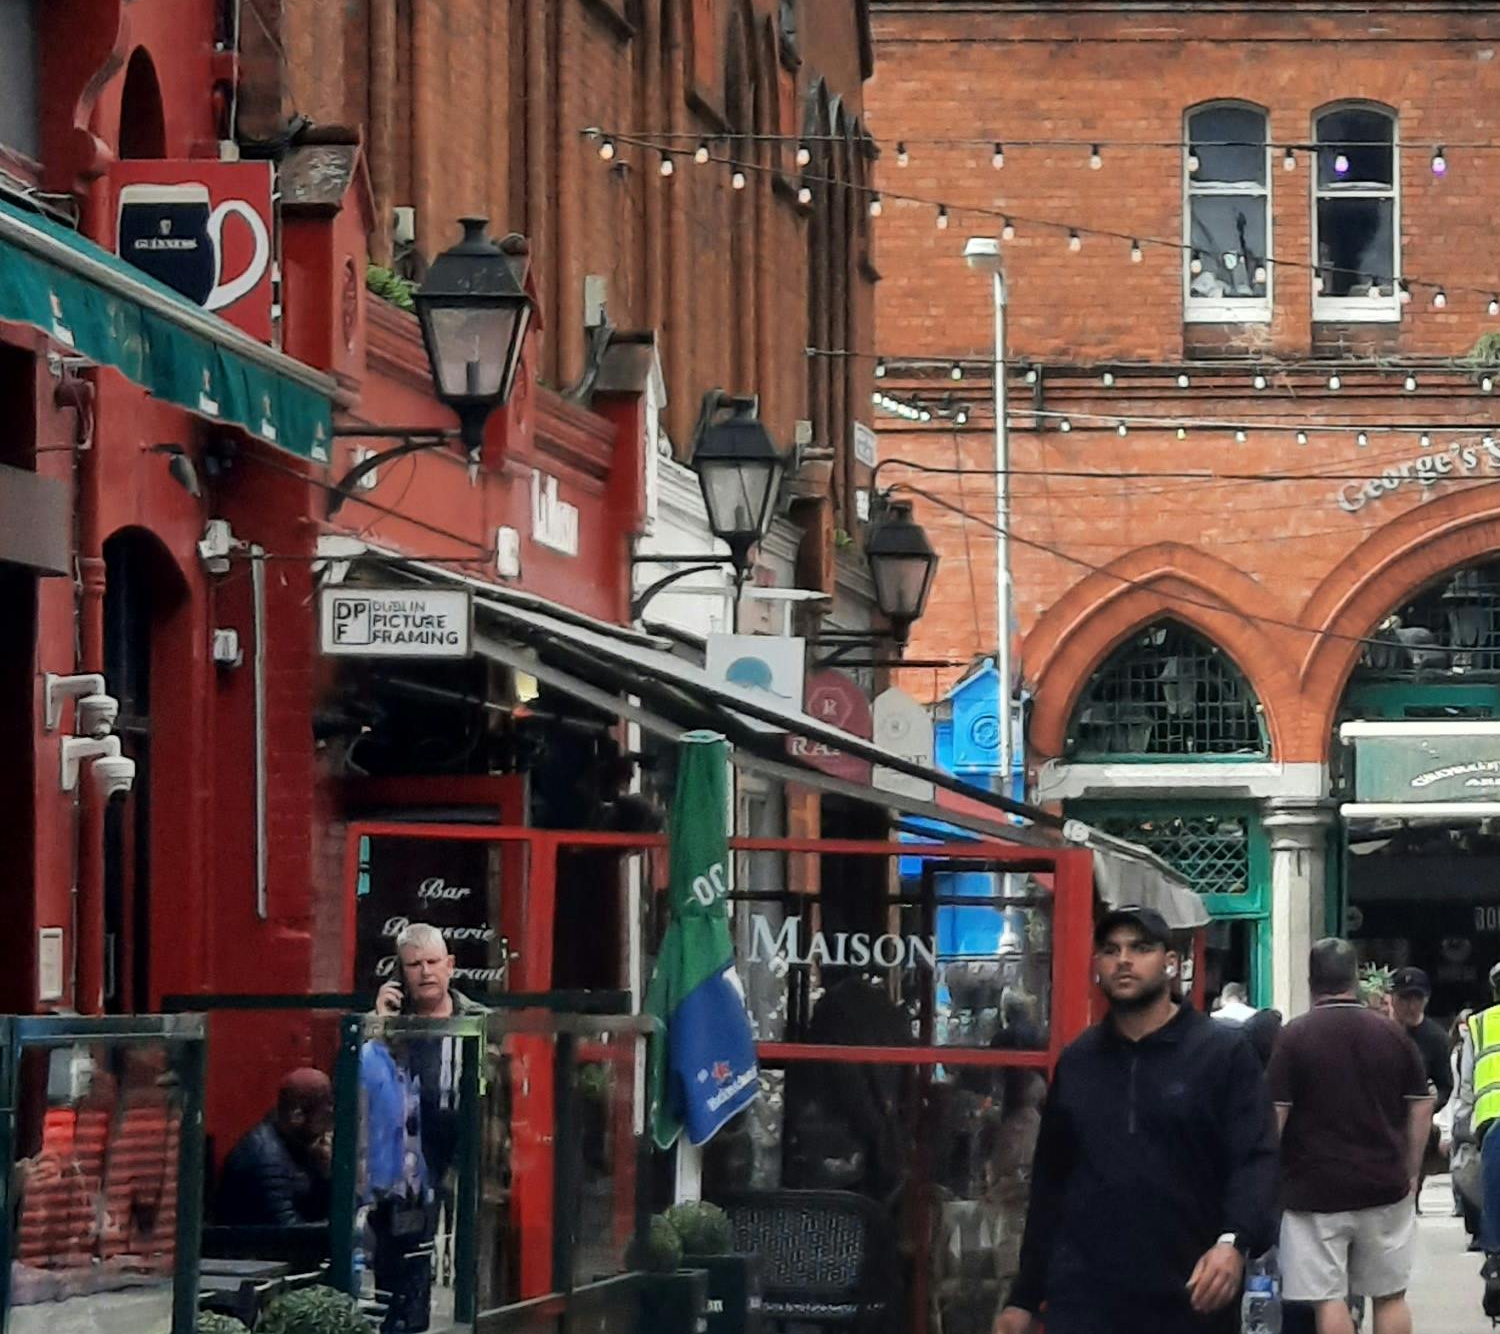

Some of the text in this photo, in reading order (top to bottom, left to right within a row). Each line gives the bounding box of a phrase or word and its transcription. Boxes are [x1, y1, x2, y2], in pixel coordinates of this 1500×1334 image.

[1337, 442, 1477, 512] George's
[372, 600, 426, 613] DUBLIN
[372, 614, 448, 629] PICTURE
[372, 630, 459, 645] FRAMING
[417, 877, 471, 901] Bar
